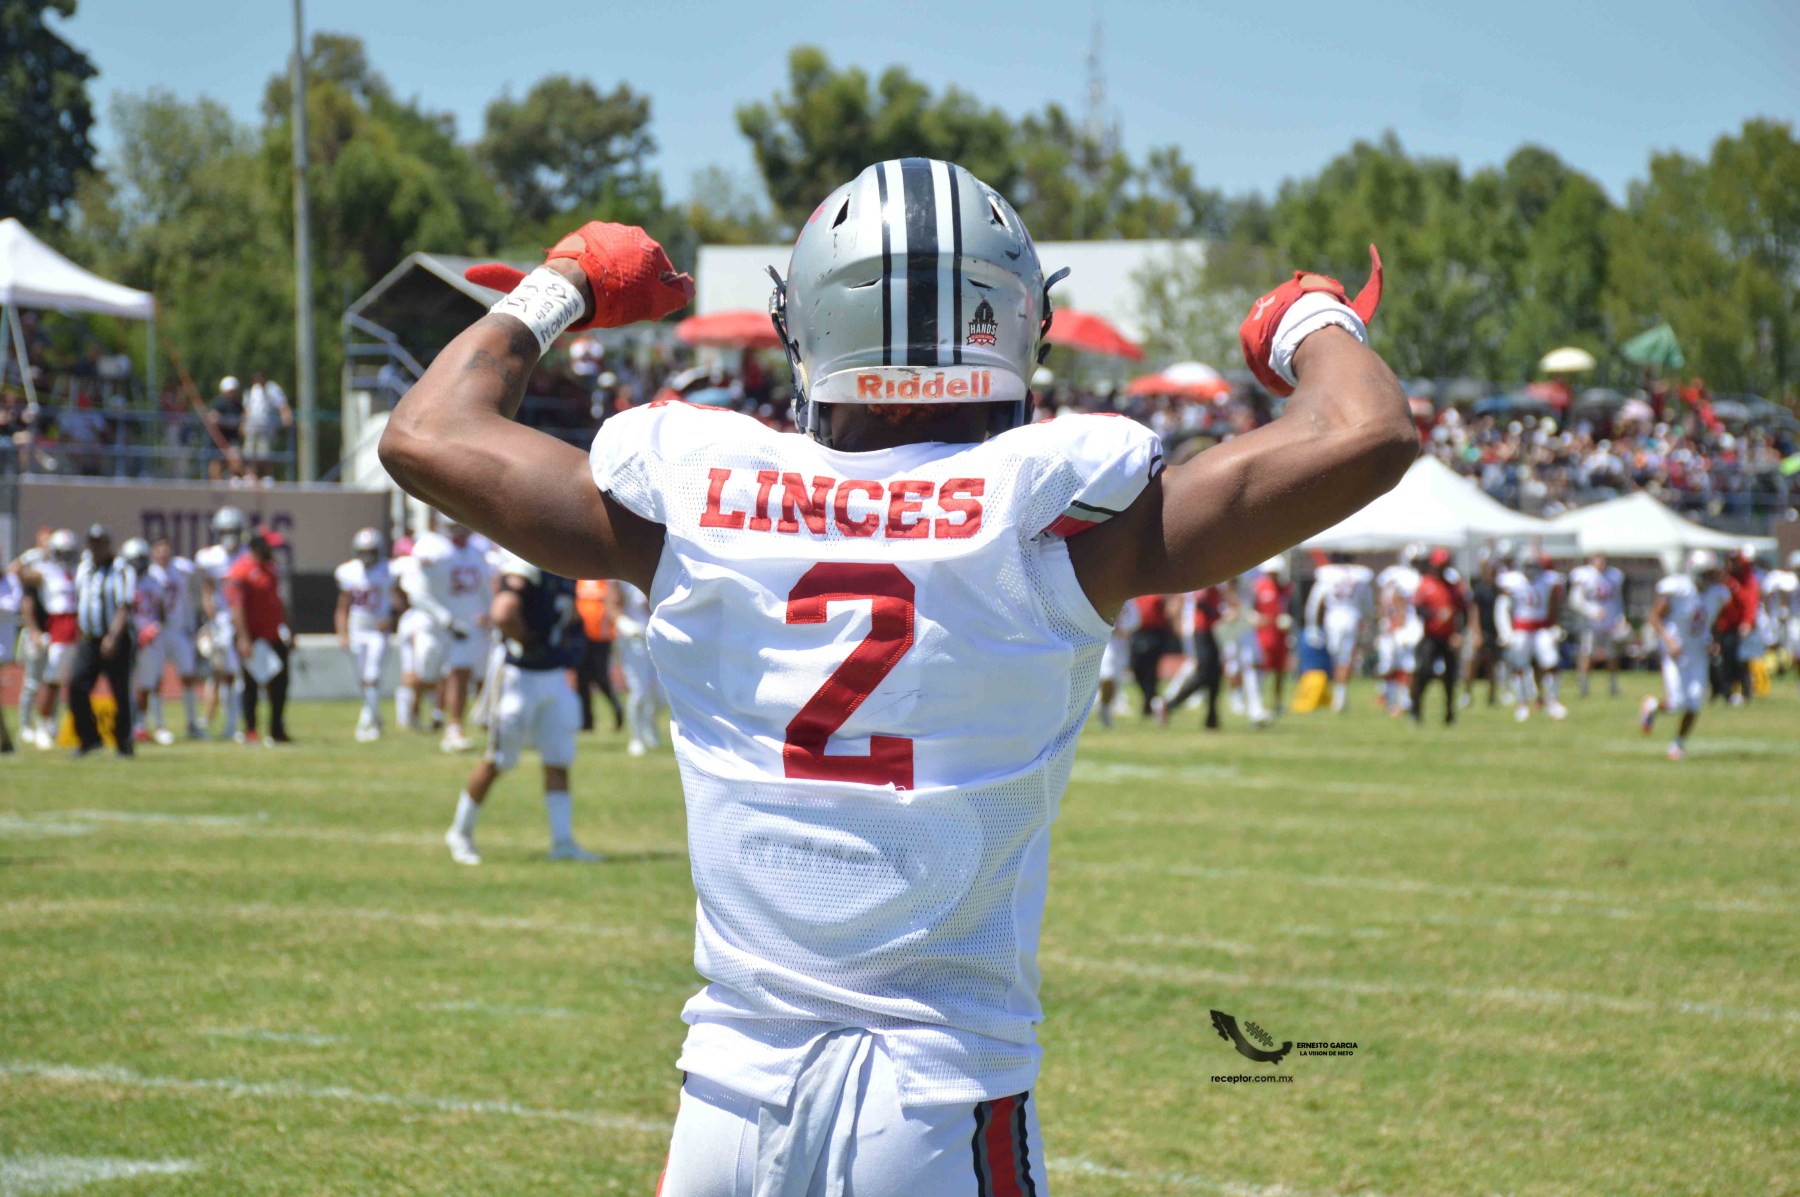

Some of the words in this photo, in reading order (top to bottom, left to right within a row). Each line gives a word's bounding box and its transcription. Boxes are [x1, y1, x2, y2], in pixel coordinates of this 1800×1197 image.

[970, 323, 997, 335] HANDS
[857, 370, 991, 399] Riddell
[700, 467, 986, 539] LINCES
[783, 562, 915, 791] 2
